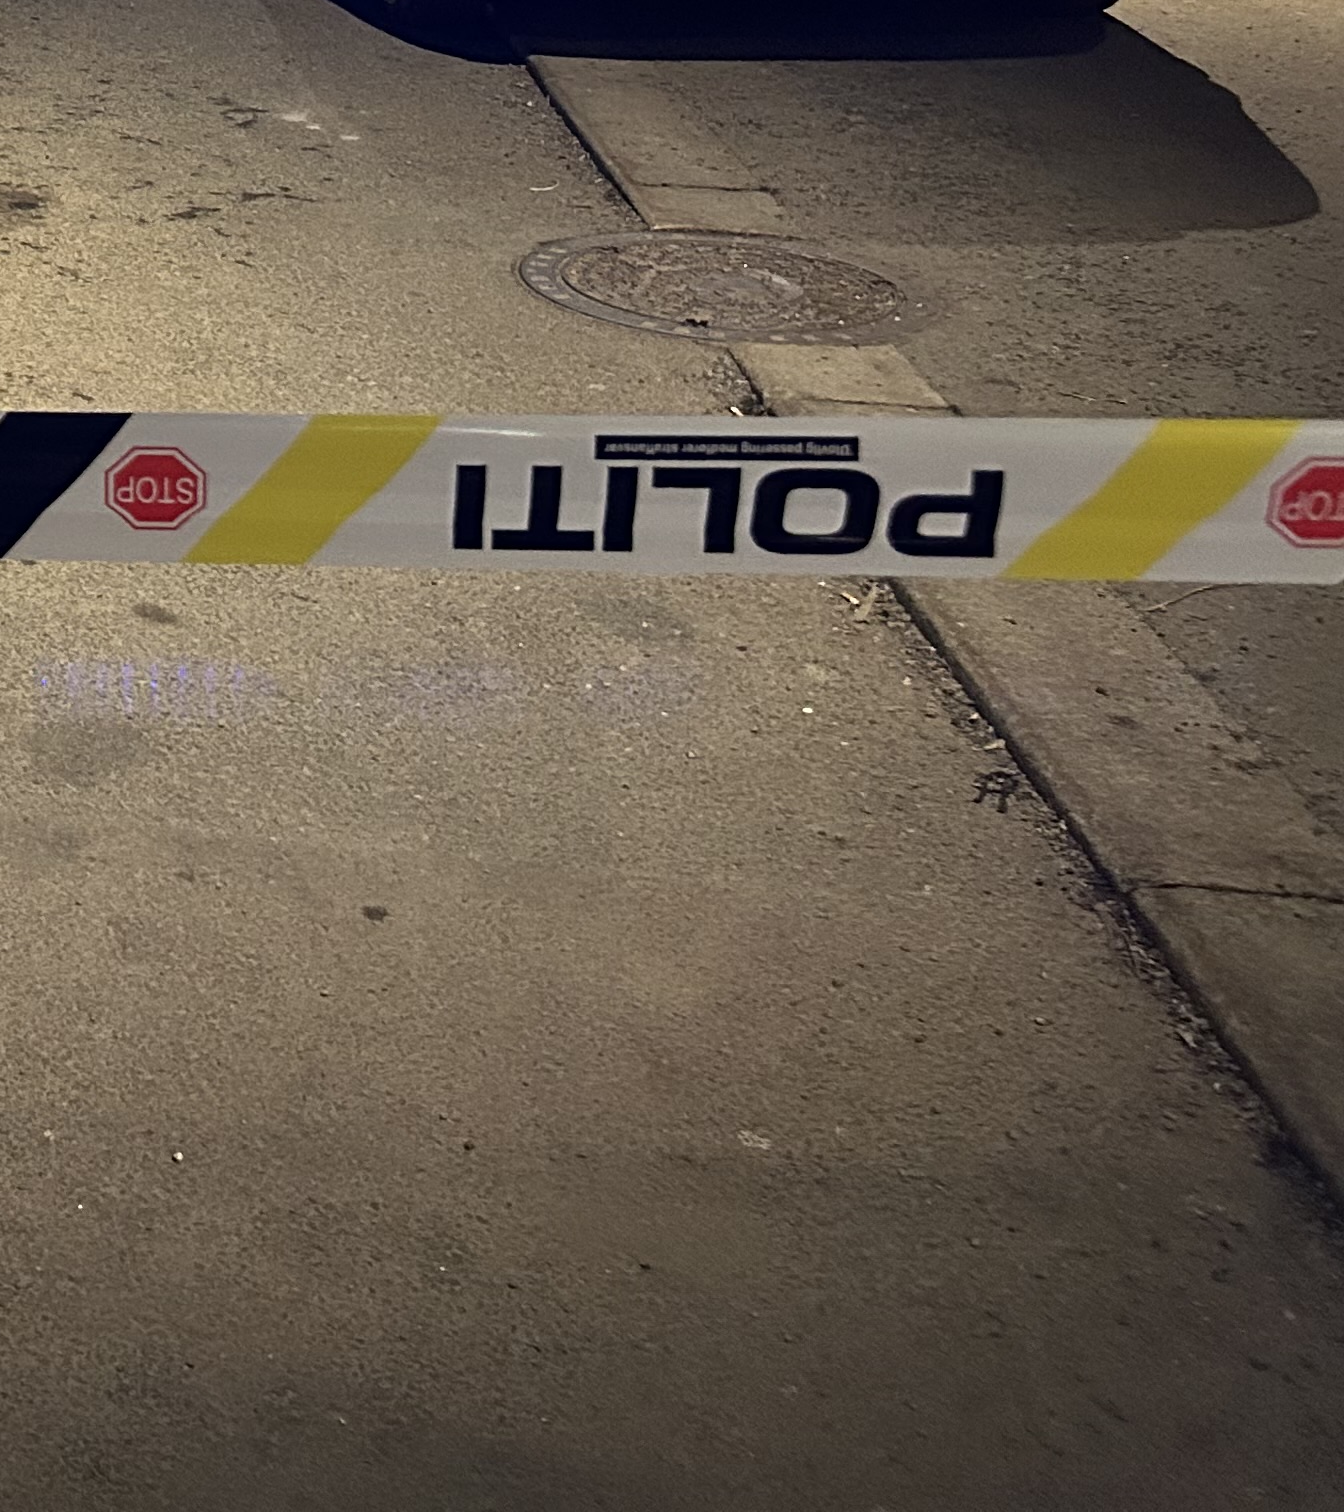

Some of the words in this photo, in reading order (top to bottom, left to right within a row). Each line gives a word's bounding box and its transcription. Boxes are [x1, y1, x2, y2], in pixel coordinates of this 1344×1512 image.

[115, 476, 195, 505] STOP
[1278, 489, 1344, 521] TOP
[452, 464, 1005, 558] POLITI
